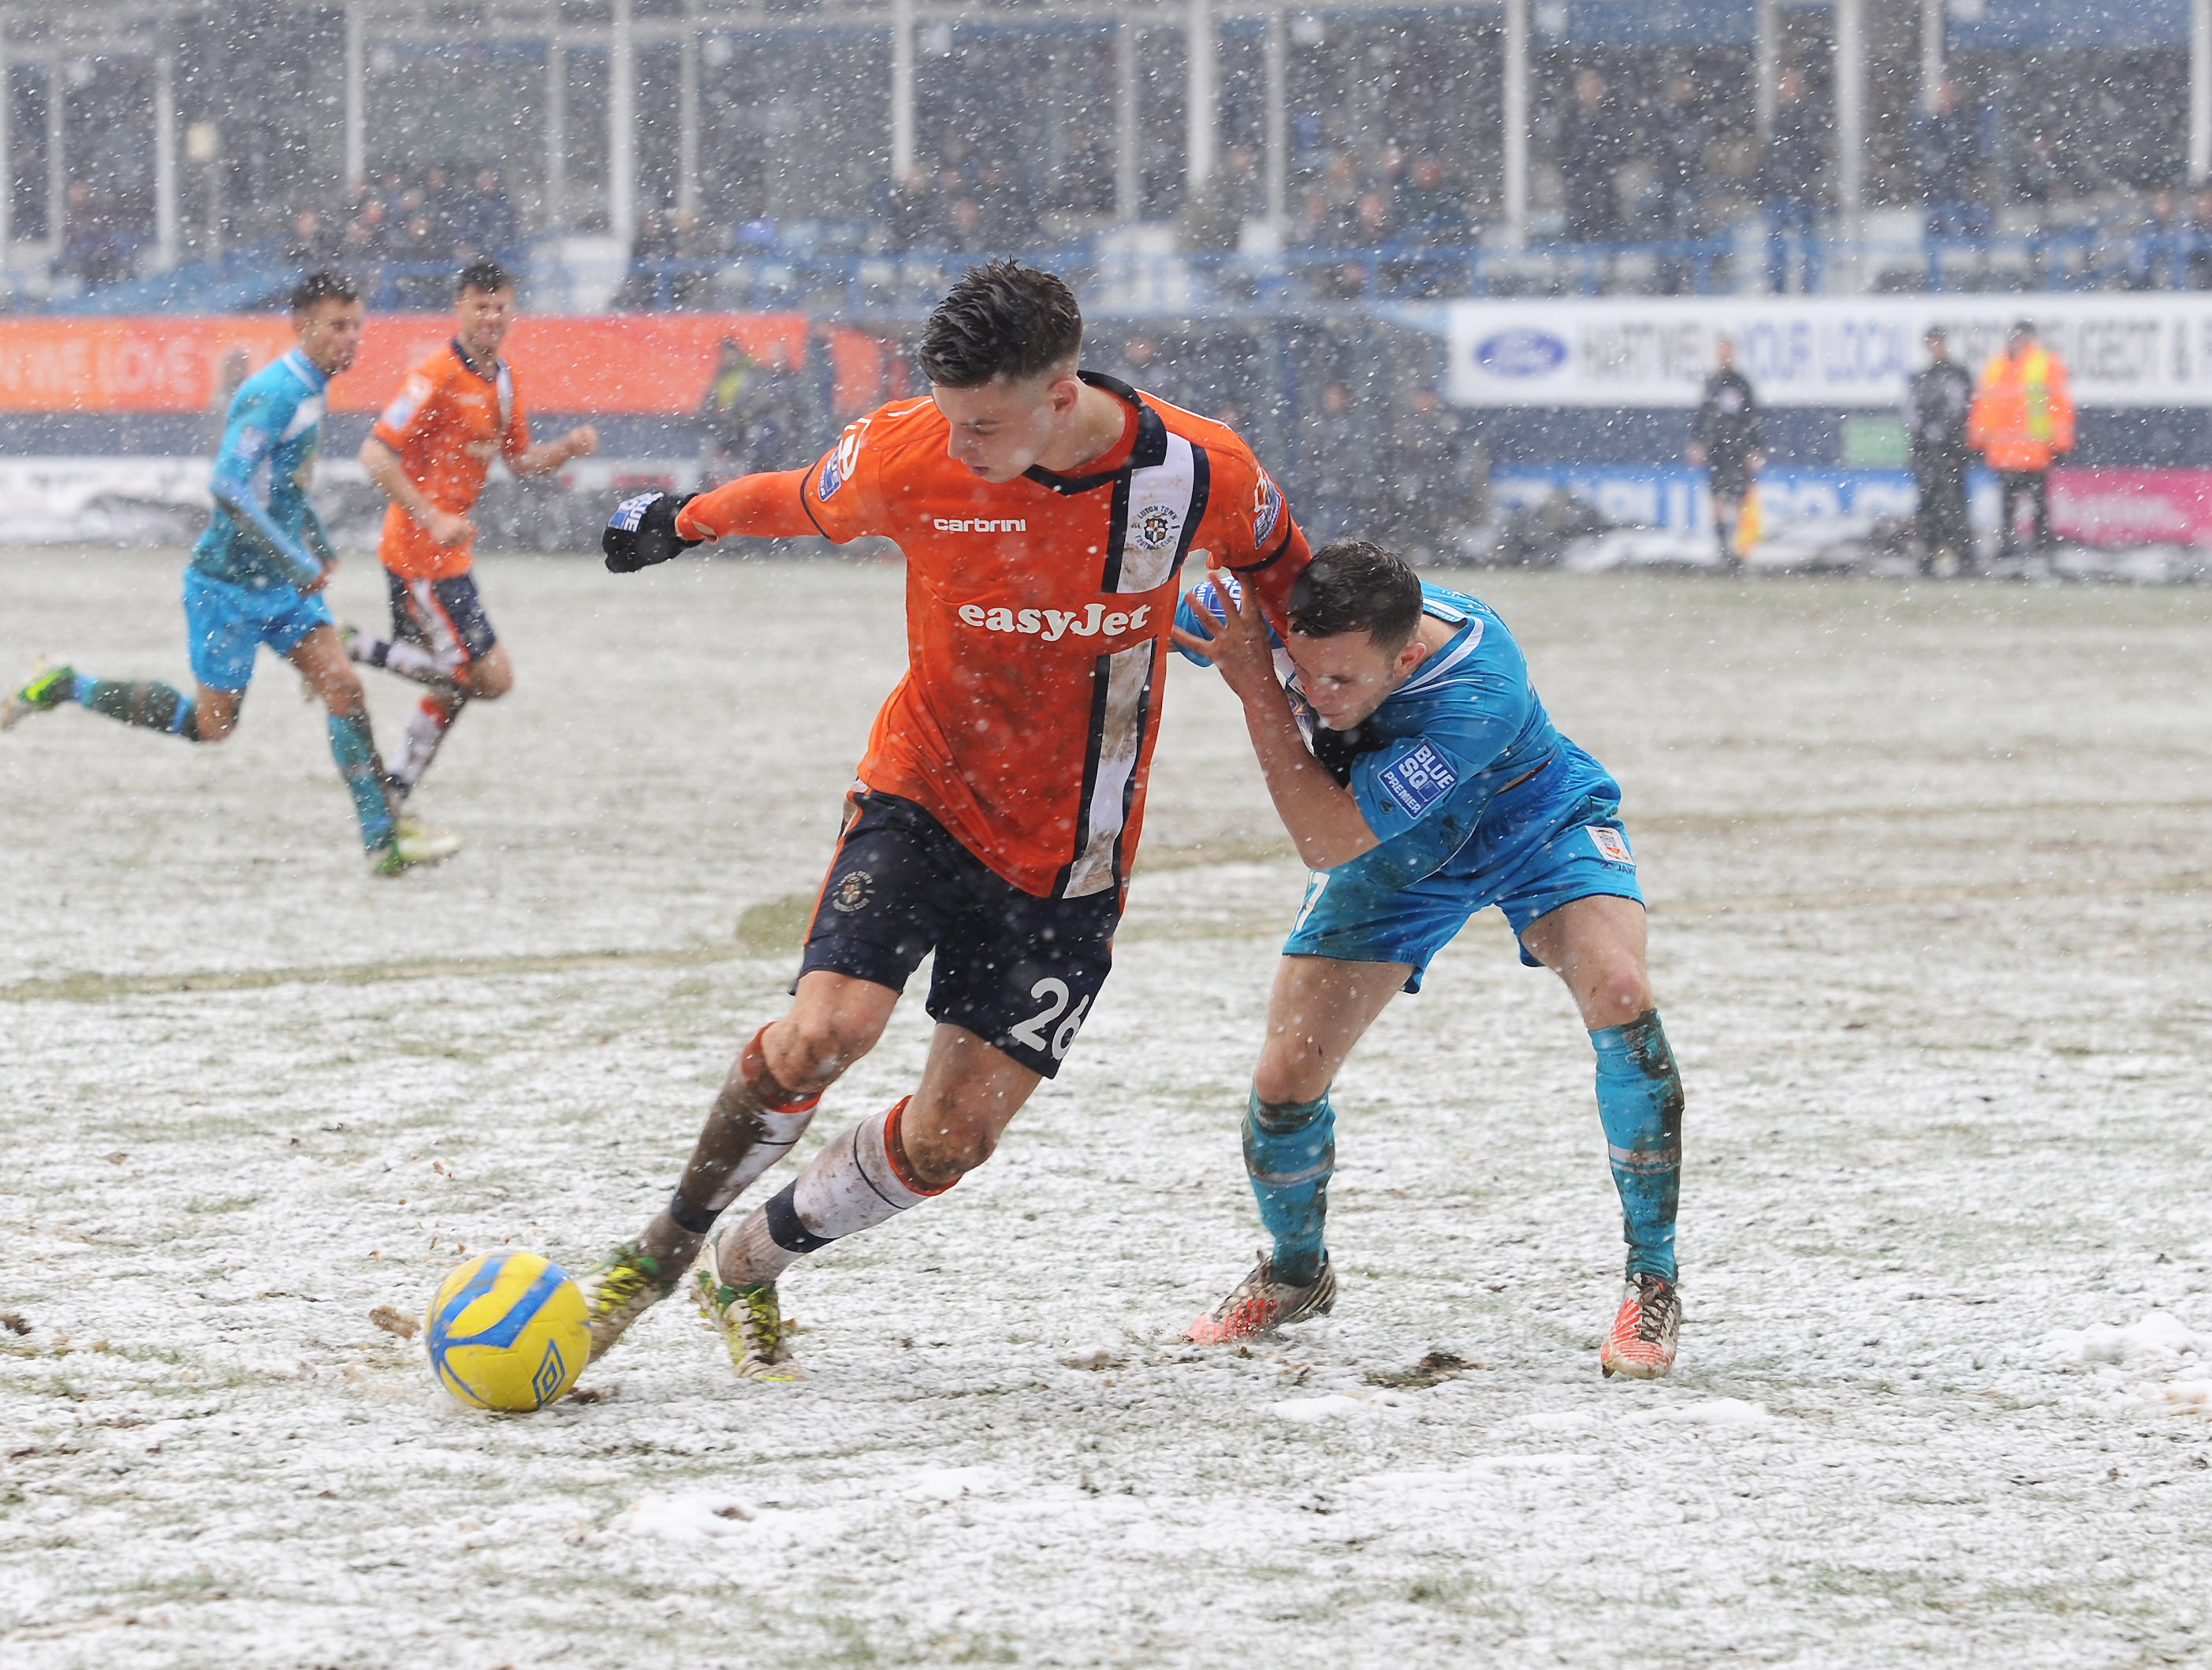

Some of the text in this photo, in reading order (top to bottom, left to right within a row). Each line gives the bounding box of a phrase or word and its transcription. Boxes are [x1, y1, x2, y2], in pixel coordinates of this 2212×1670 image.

[933, 518, 1026, 532] carbrini
[1137, 505, 1178, 520] LUTON TOWN
[958, 603, 1151, 642] easyJet
[1398, 757, 1428, 790] SQ
[1413, 744, 1455, 789] BLUE
[1383, 770, 1421, 814] PREMIER
[1618, 863, 1636, 877] JAK
[1011, 977, 1089, 1061] 26
